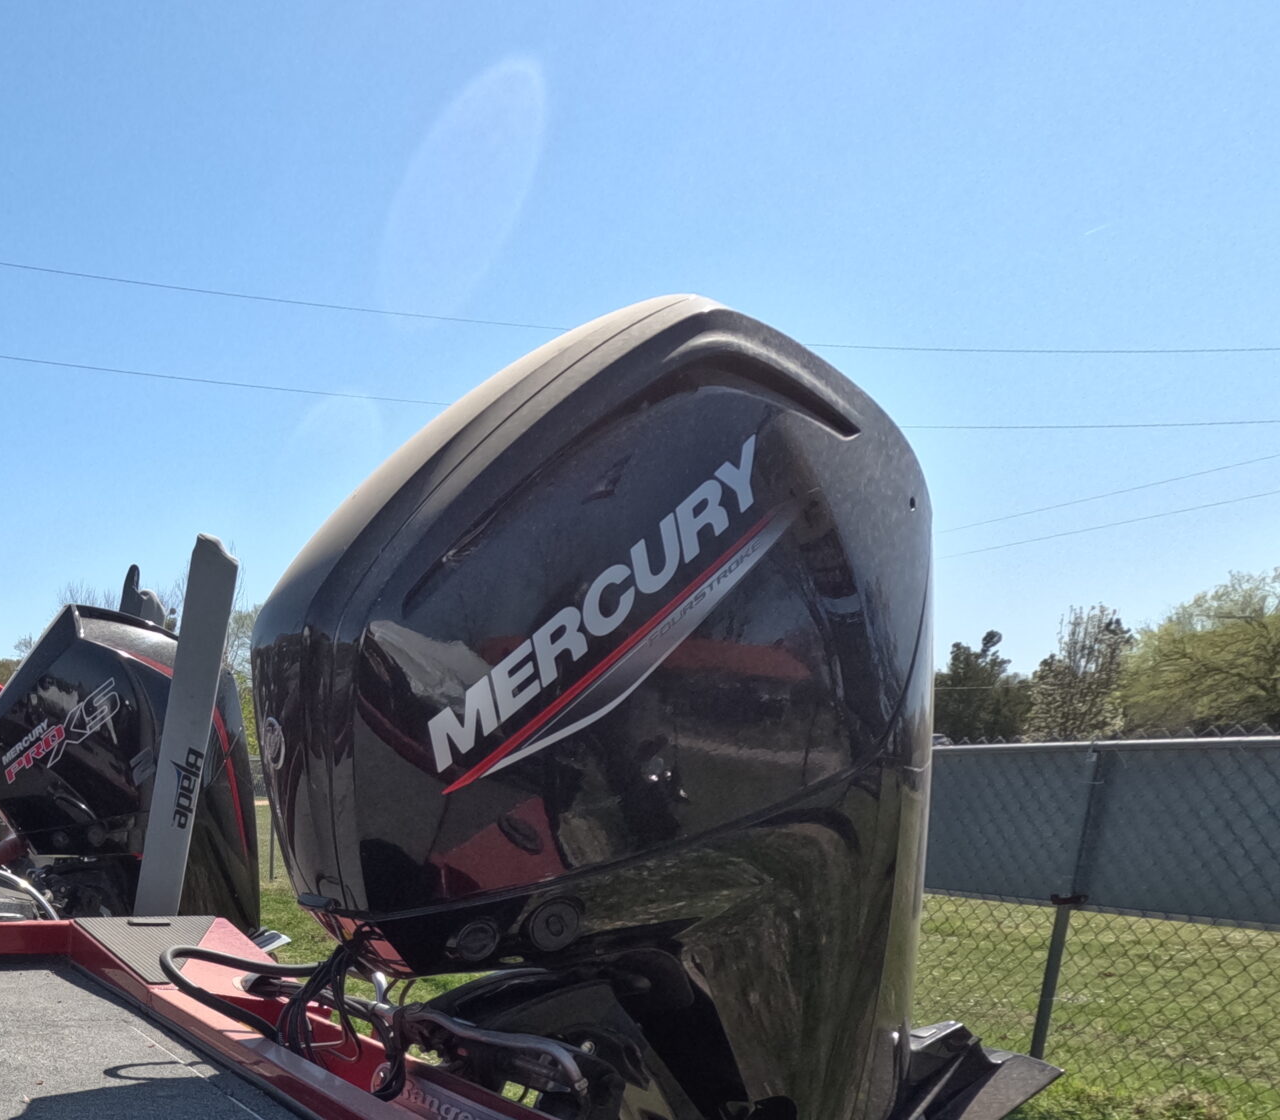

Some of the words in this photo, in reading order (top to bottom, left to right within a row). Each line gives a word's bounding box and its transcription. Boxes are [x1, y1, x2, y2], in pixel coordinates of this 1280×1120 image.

[426, 432, 757, 774] MERCURY
[647, 539, 762, 648] FOURSTROKE
[2, 718, 49, 766] MERCURY
[169, 746, 205, 830] Blade
